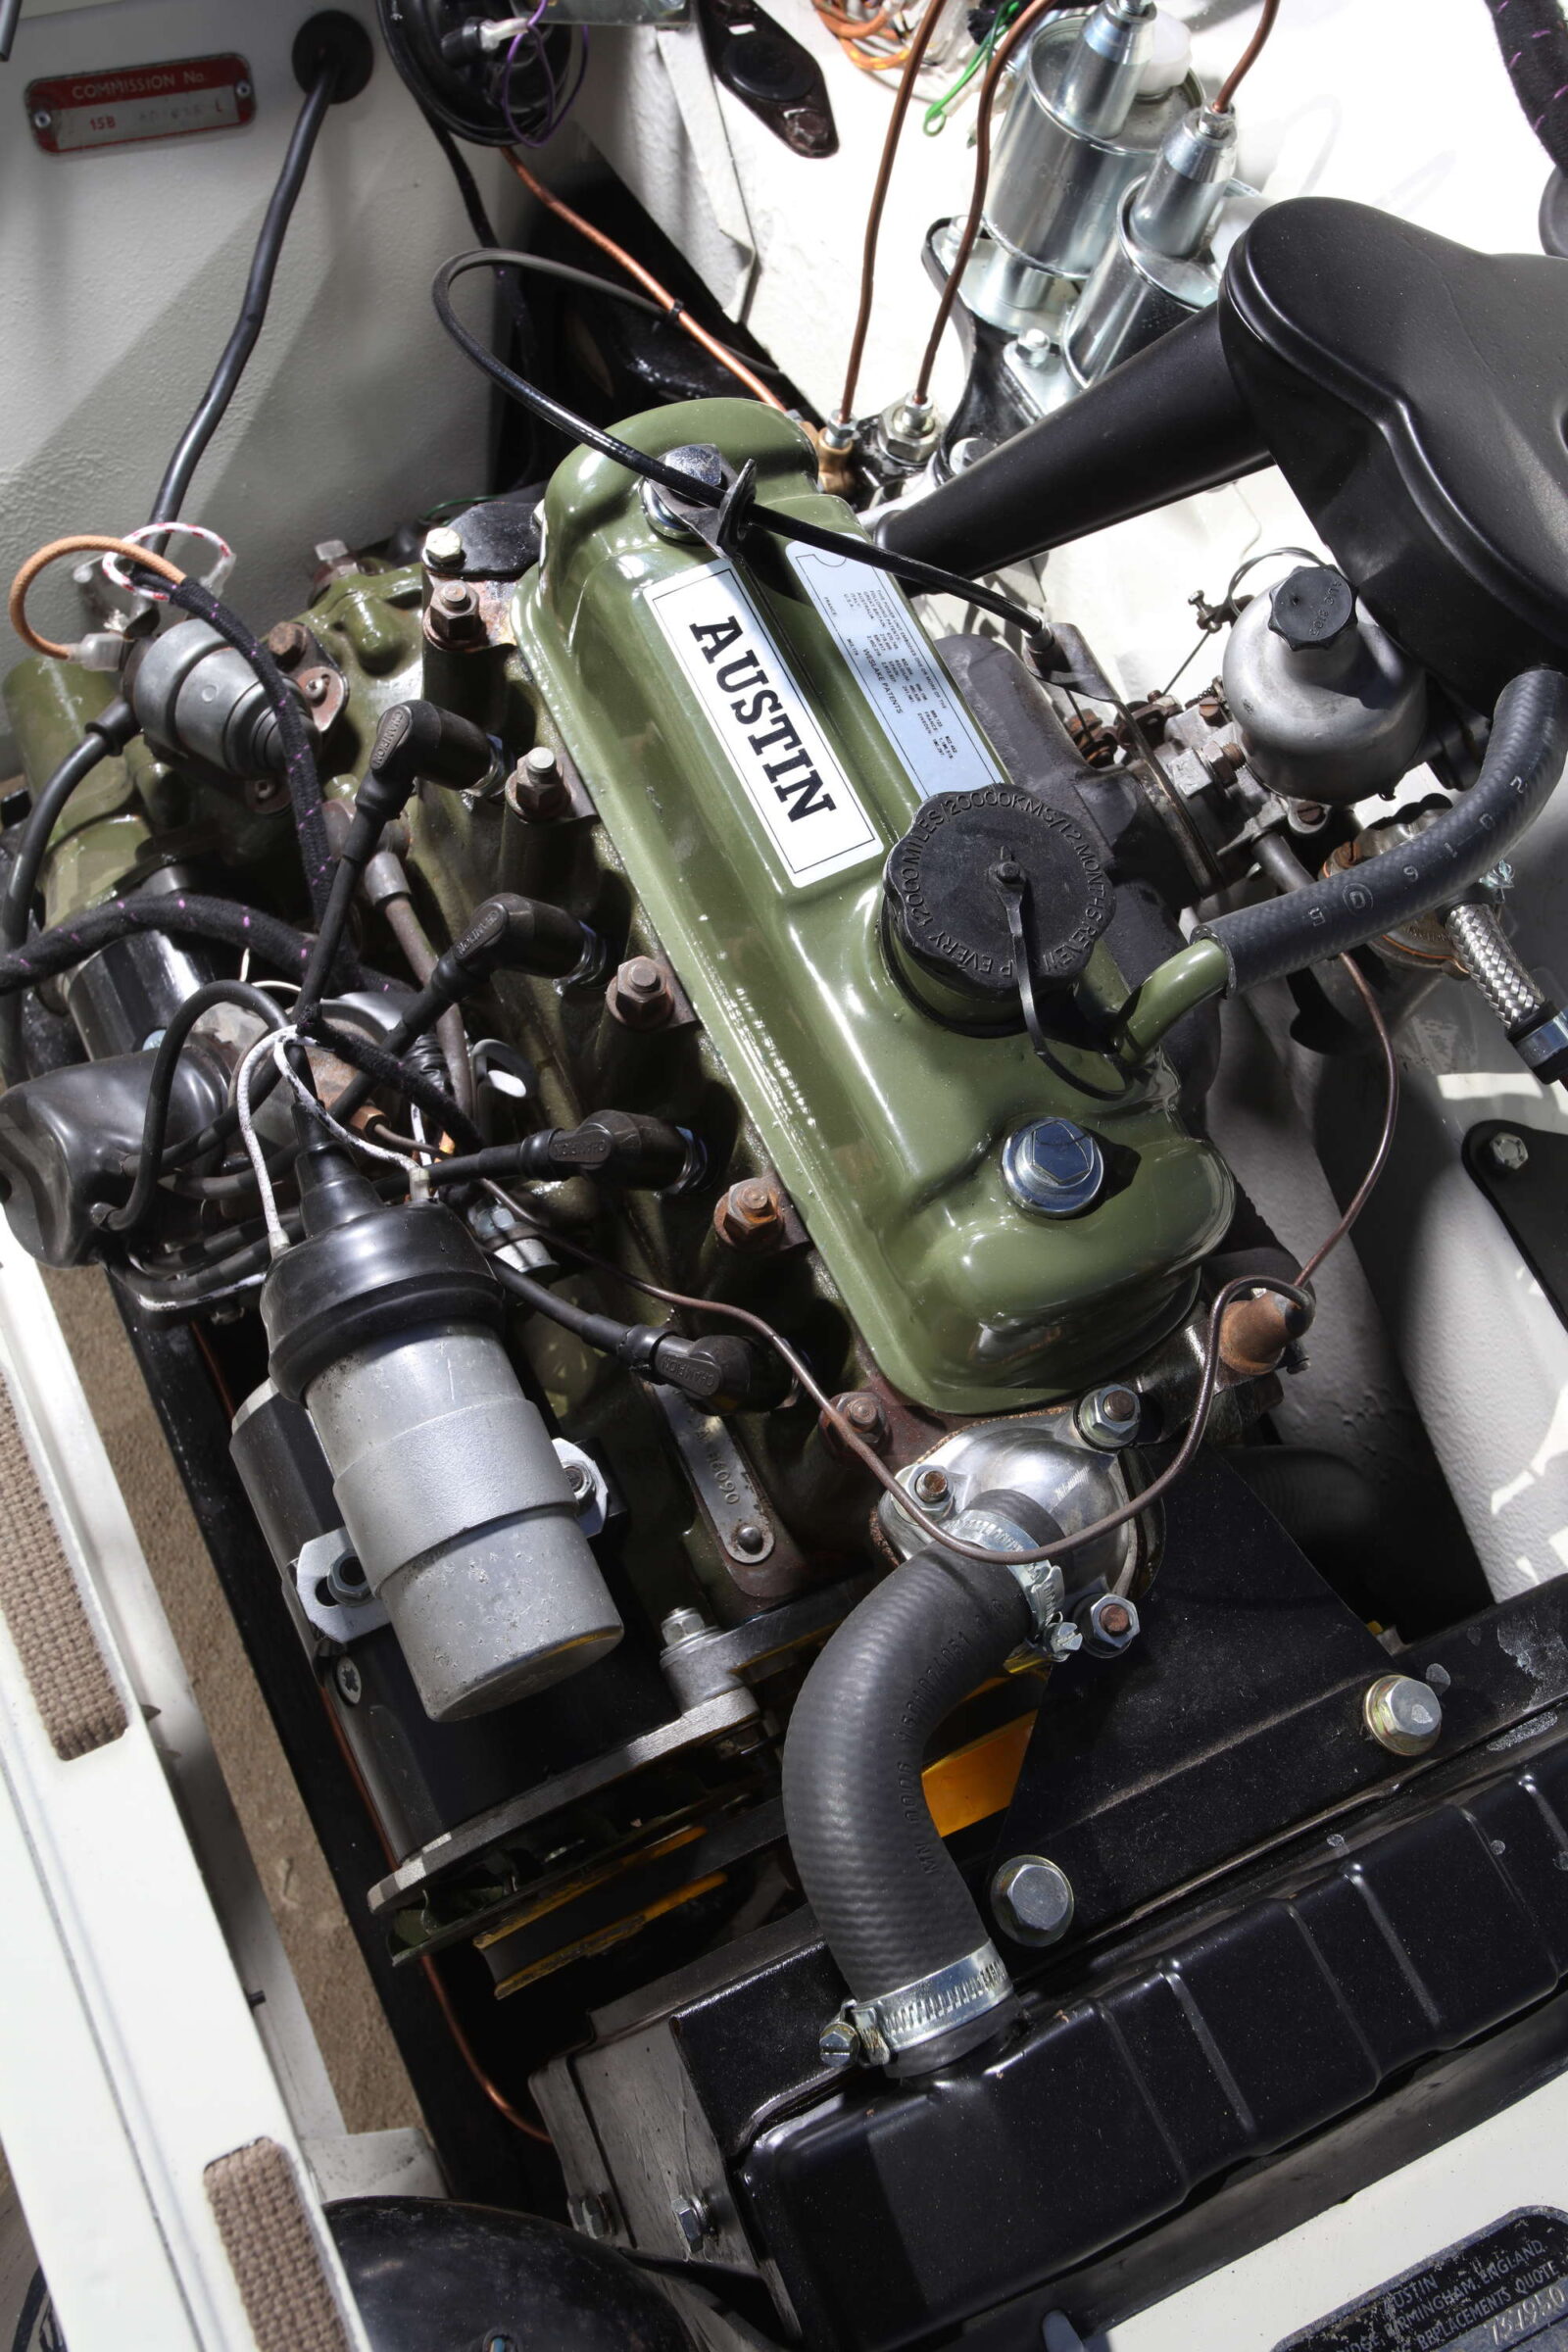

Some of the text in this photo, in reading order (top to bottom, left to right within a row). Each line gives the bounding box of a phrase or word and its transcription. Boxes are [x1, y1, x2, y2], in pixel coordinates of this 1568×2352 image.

[71, 70, 175, 102] COMMISSION
[860, 648, 904, 713] WESLAKE PATENTS
[370, 709, 404, 766] CHAMPION
[689, 615, 837, 822] AUSTIN
[928, 931, 994, 975] EVERY
[659, 1355, 715, 1388] CHAMPION
[1511, 2258, 1560, 2297] QUOTE
